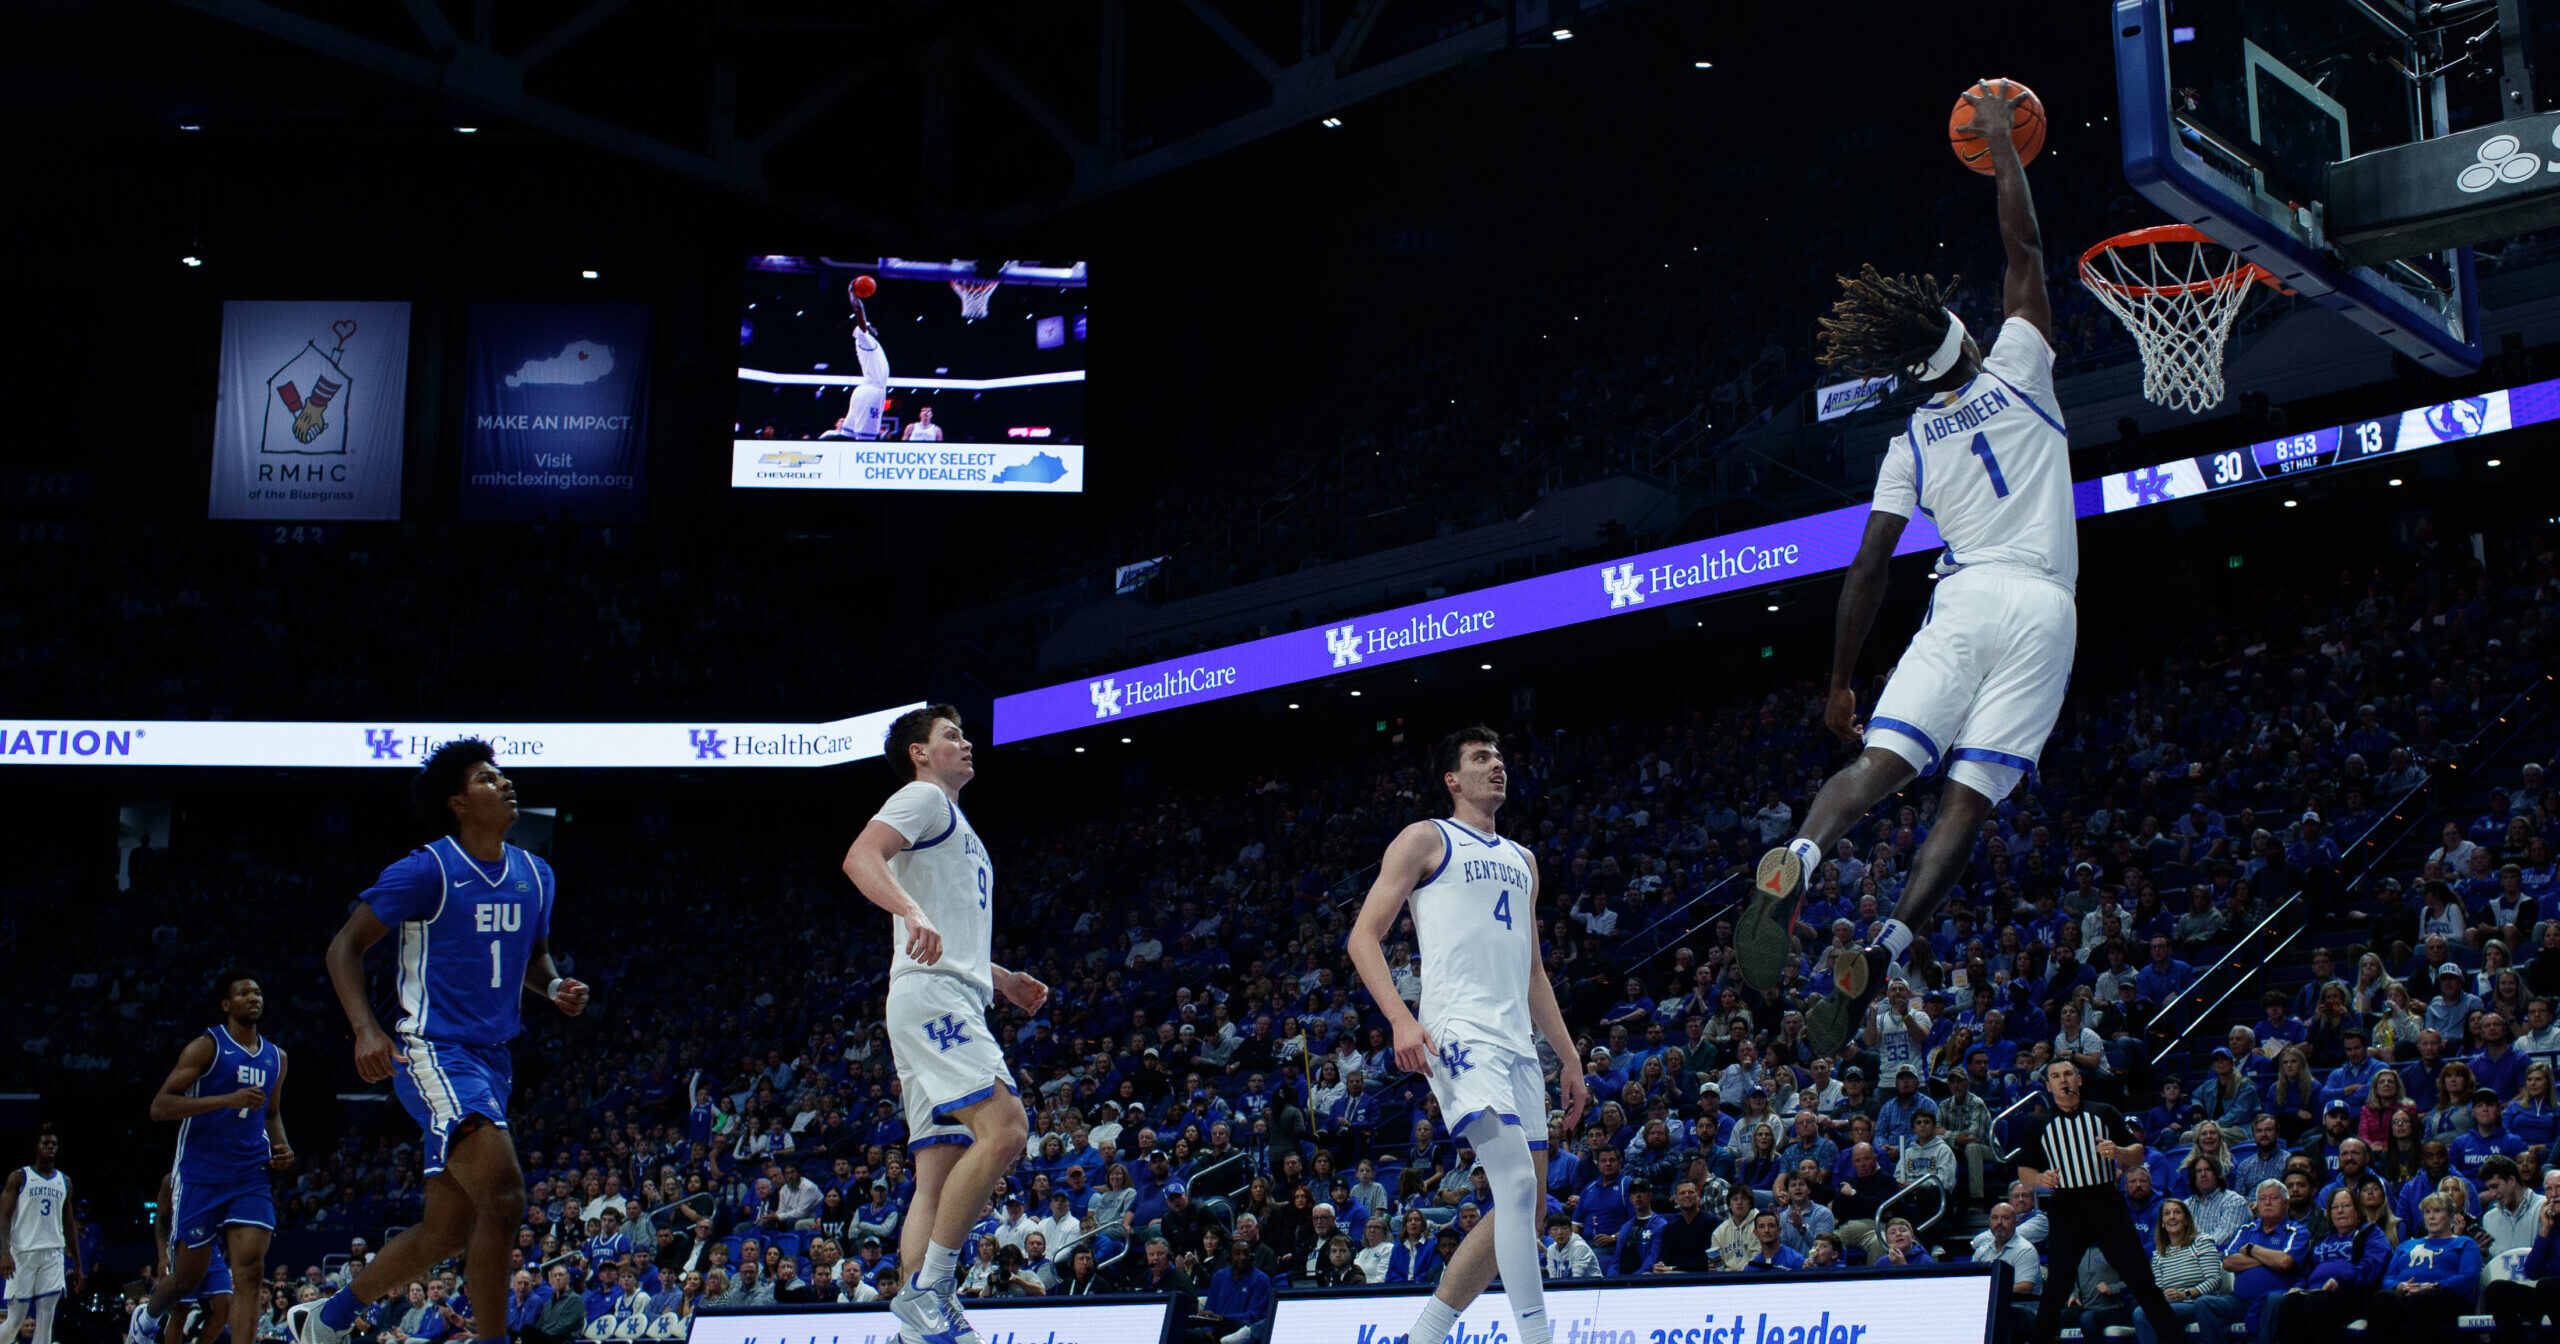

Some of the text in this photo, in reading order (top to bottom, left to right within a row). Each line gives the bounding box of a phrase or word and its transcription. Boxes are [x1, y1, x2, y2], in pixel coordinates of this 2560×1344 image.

[477, 415, 529, 430] MAKE
[532, 416, 559, 430] AN
[1923, 387, 2010, 446] ABERDEEN
[2275, 434, 2317, 459] 8:53
[2355, 421, 2383, 455] 13
[258, 464, 347, 482] RMHC
[534, 453, 573, 468] Visit
[855, 452, 997, 467] KENTUCKY SELECT
[1971, 431, 2010, 499] 1
[2280, 456, 2319, 474] 1ST HALF
[472, 471, 633, 490] rmhclexington.org
[756, 472, 823, 480] CHEVROLET
[865, 467, 986, 482] CHEVY DEALERS
[2126, 450, 2243, 505] UK 30
[248, 489, 355, 502] of the Bluegrass
[1601, 543, 1799, 609] UK HealthCare
[1325, 610, 1495, 669] UK HealthCare
[1089, 666, 1236, 719] UK HealthCare
[365, 729, 544, 759] UK HeCare
[689, 729, 853, 759] UK HealthCare
[978, 866, 988, 910] 9
[1464, 861, 1529, 895] KENTUCKY
[474, 903, 521, 932] EIU
[1493, 890, 1512, 931] 4
[490, 939, 502, 988] 1
[922, 1013, 972, 1053] UK
[1439, 1041, 1476, 1079] UK
[1886, 1044, 1910, 1062] 33
[237, 1064, 267, 1088] EIU
[2464, 1154, 2489, 1165] WILDC
[29, 1186, 64, 1201] KENTUCKY
[40, 1199, 52, 1216] 3
